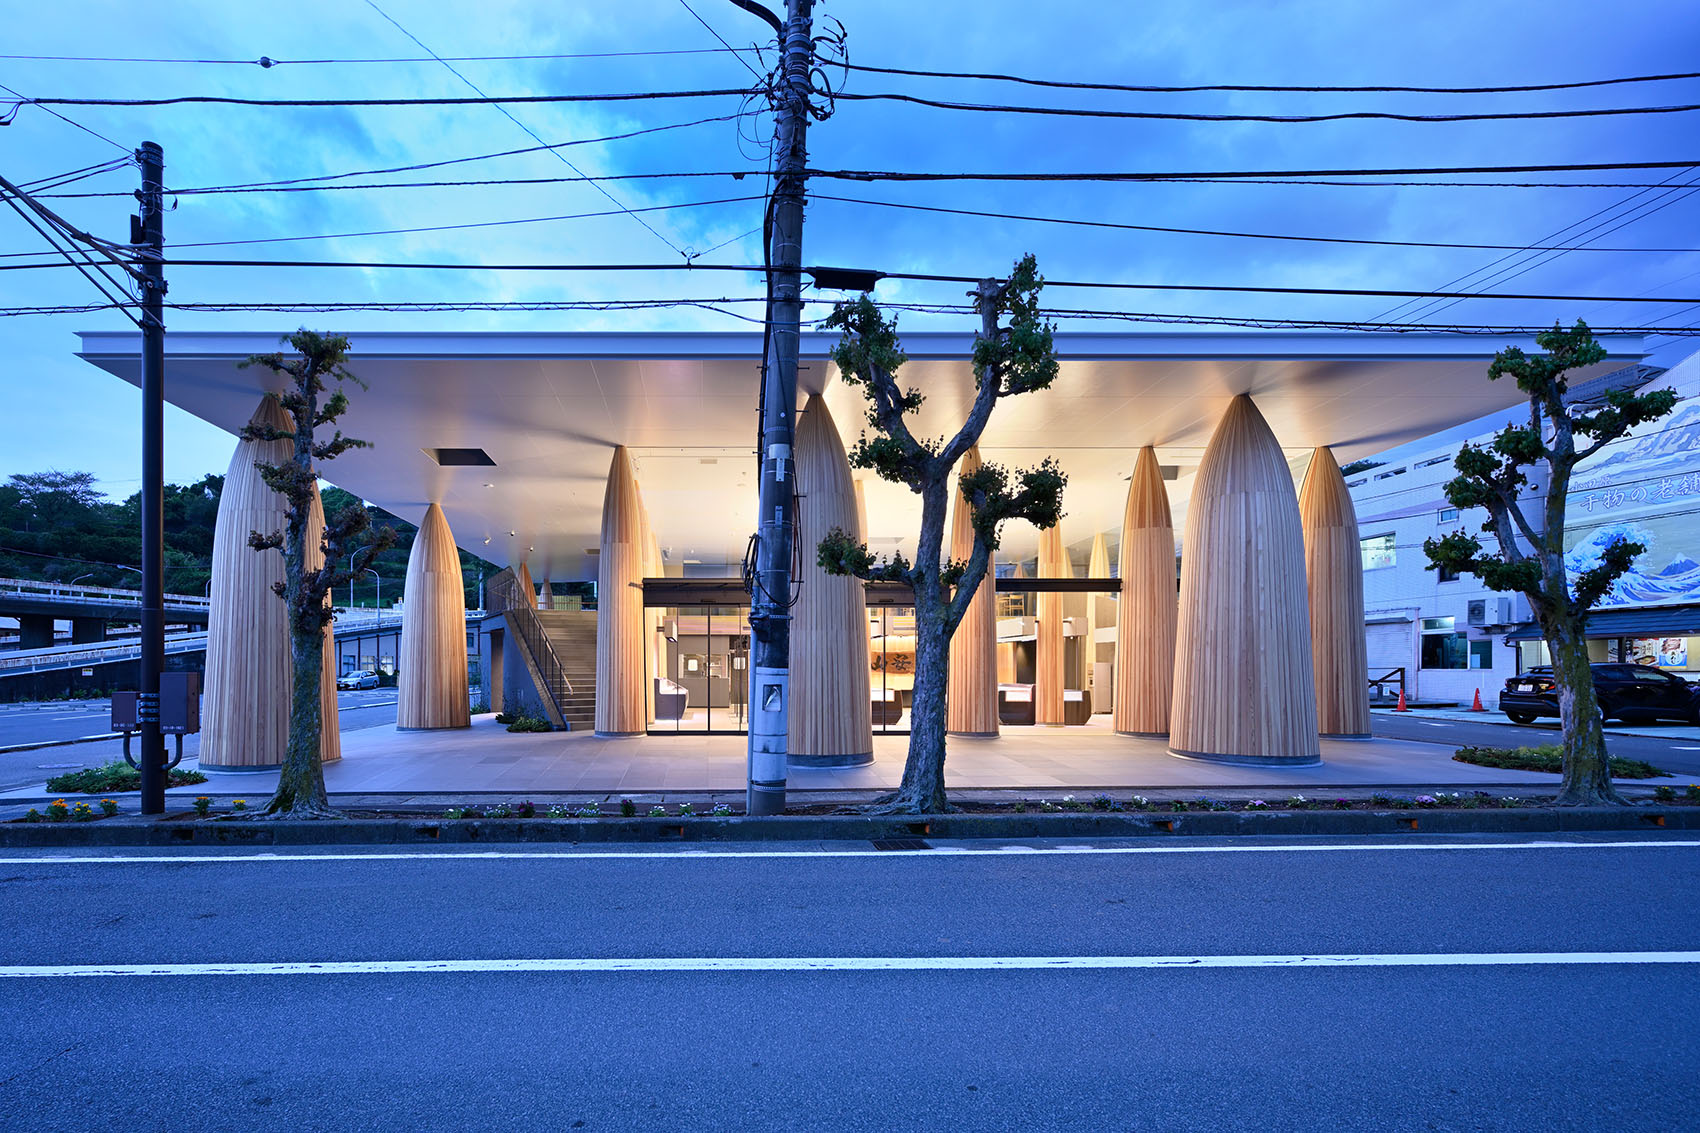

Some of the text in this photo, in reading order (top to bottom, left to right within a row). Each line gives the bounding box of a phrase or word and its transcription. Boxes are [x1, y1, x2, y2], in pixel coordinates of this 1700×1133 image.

[1580, 472, 1700, 512] 干物の老舗
